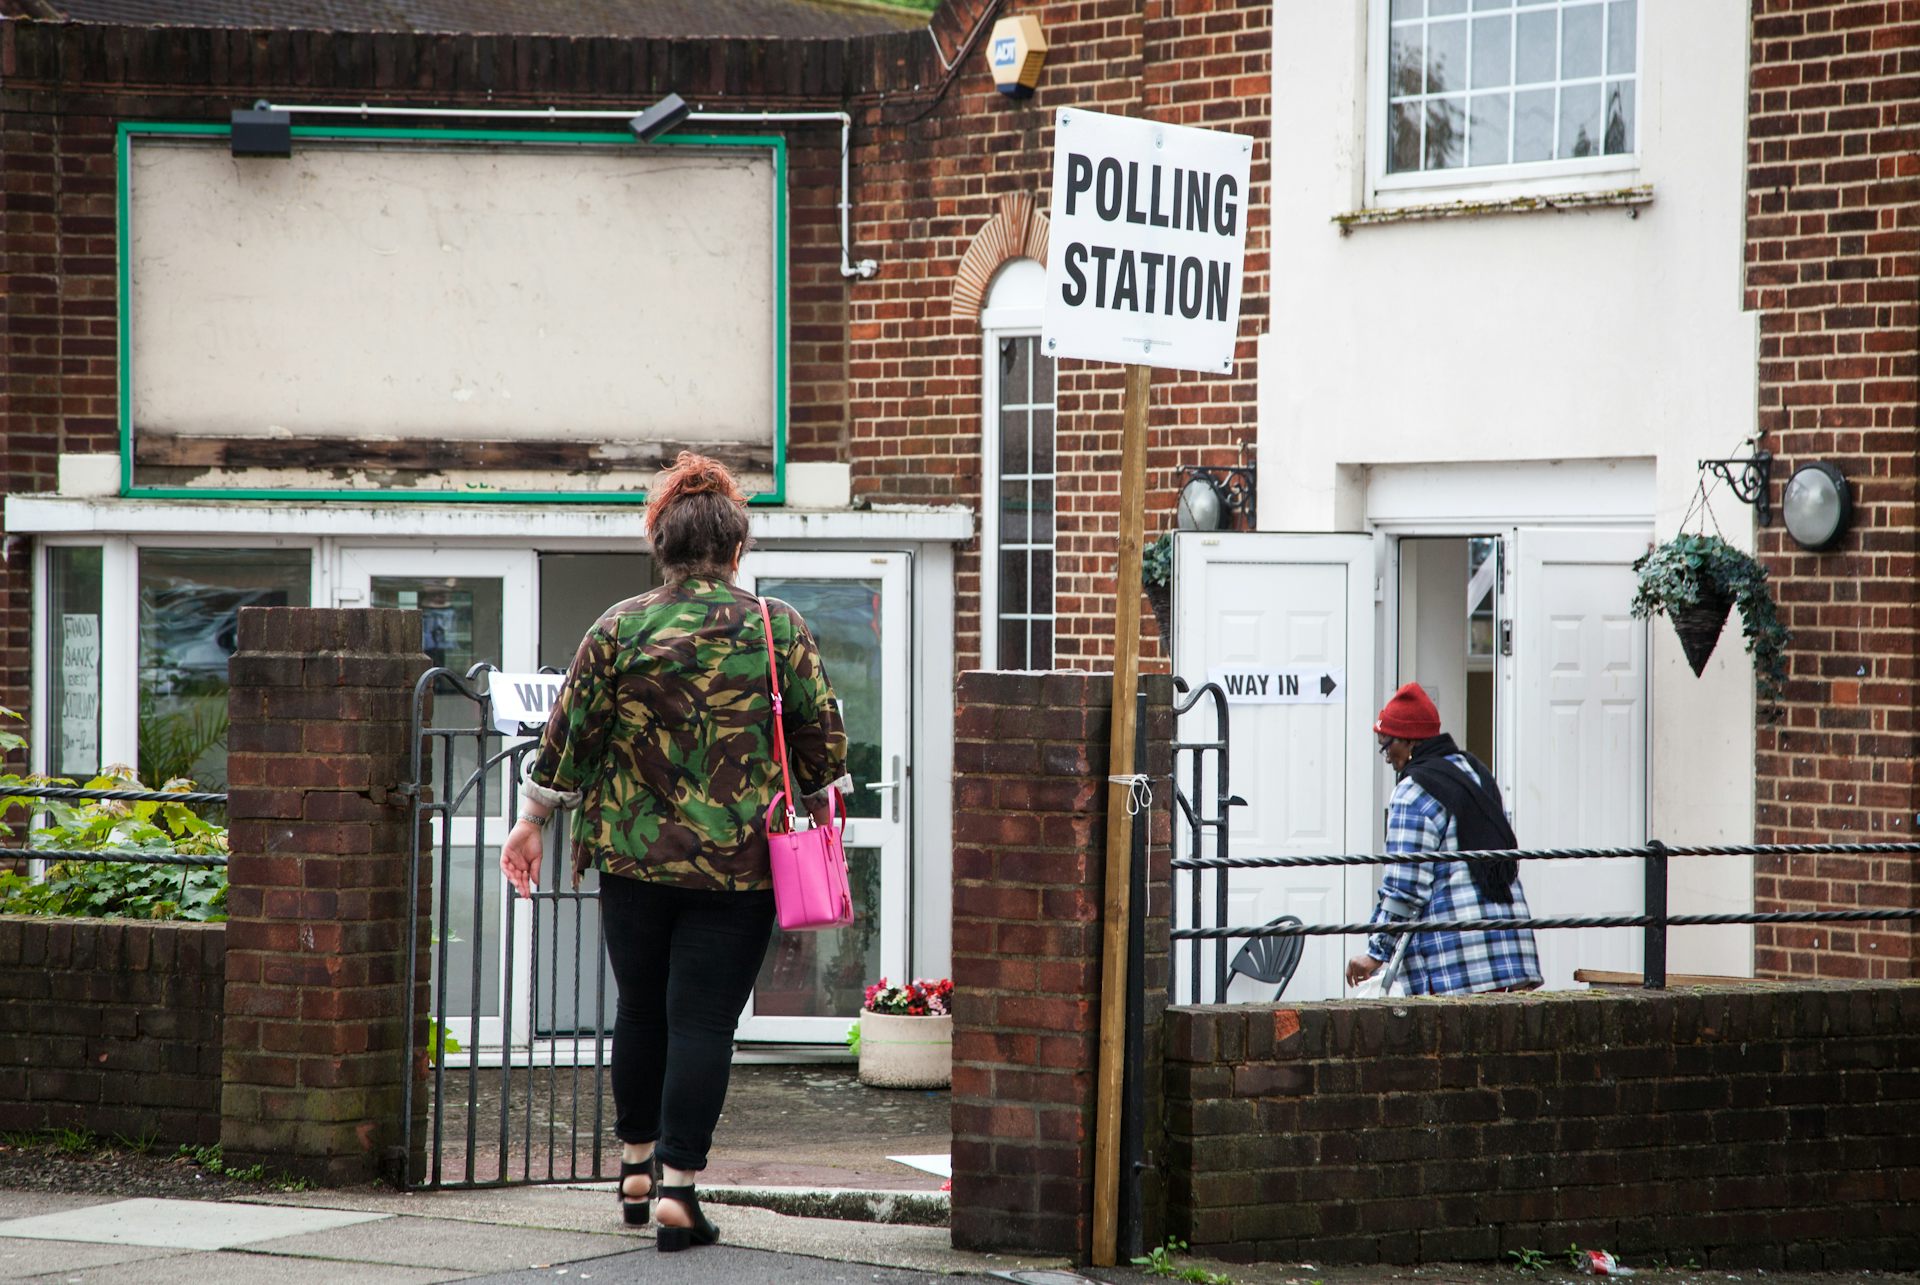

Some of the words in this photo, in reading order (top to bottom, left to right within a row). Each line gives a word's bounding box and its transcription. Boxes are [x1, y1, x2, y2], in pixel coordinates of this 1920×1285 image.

[1065, 152, 1238, 237] POLLING
[1062, 242, 1231, 322] STATION
[64, 616, 93, 639] FOOD
[64, 645, 94, 669] BANK
[1224, 674, 1269, 696] WAY
[1278, 674, 1299, 696] IN
